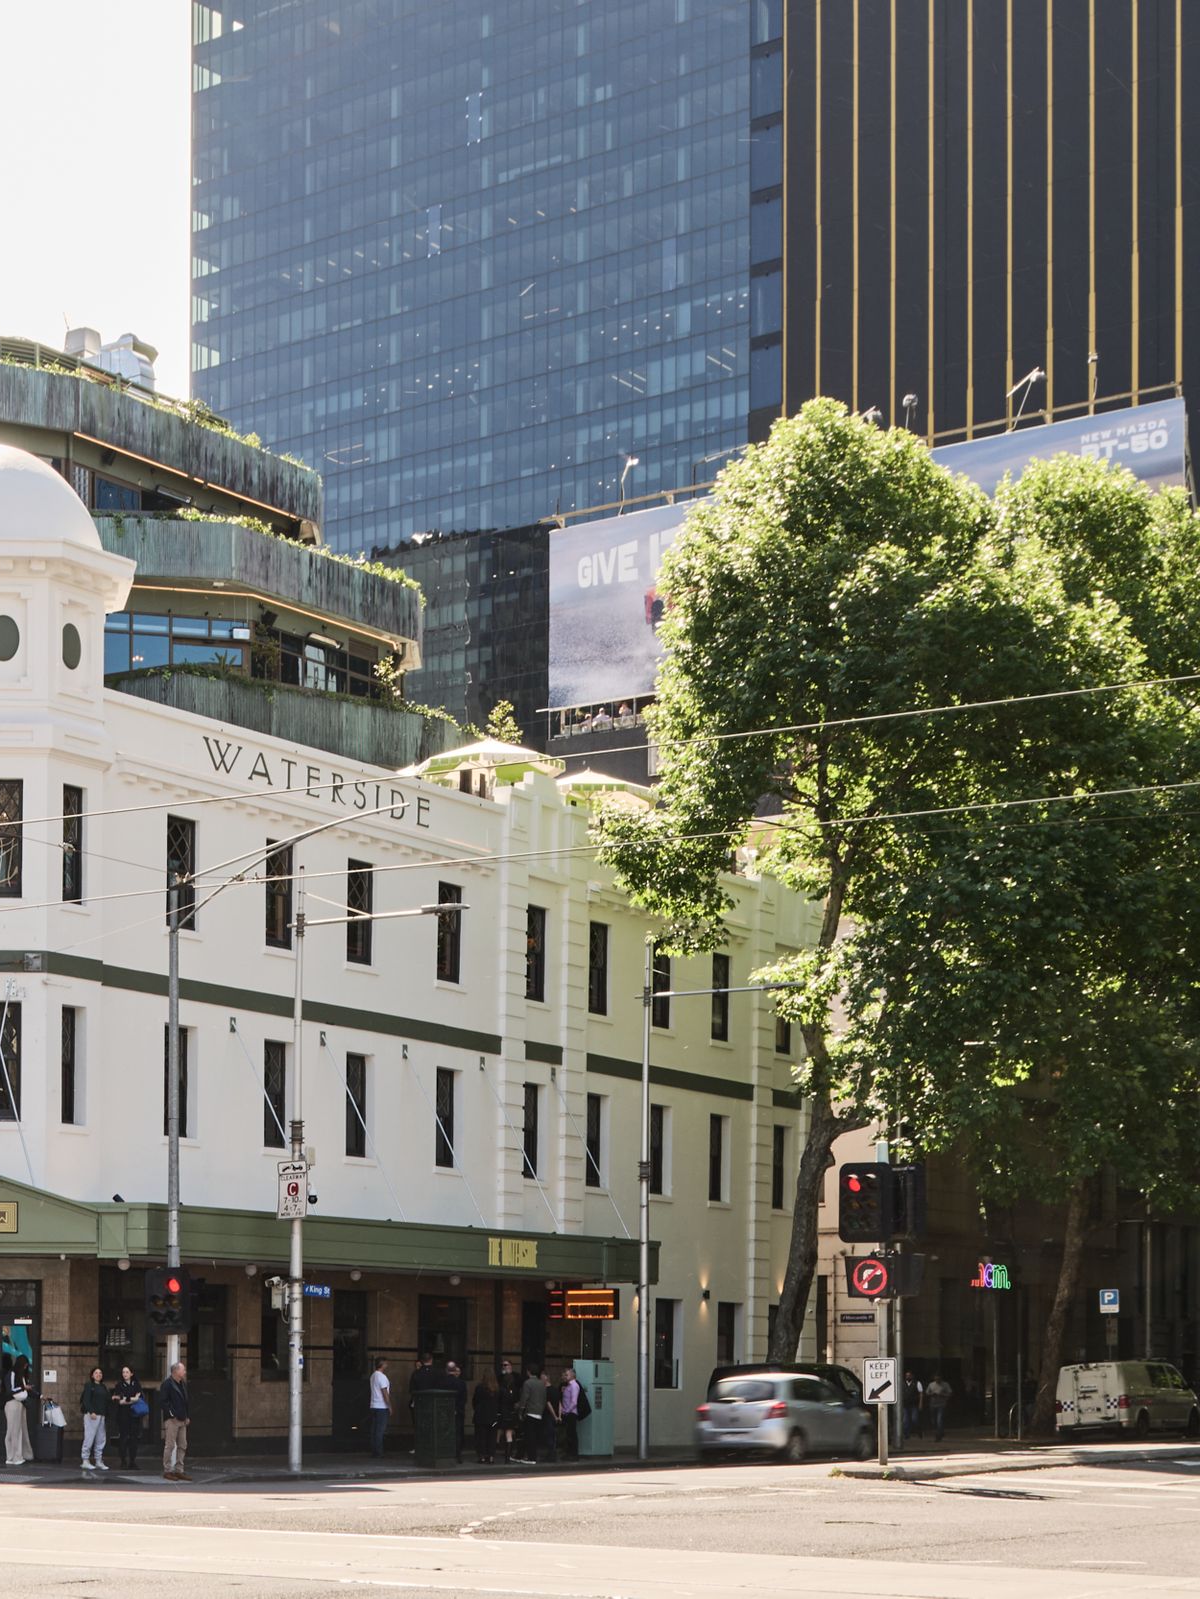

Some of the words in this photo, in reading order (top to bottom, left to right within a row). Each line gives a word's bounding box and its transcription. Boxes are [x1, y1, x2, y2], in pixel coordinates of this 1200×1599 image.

[1081, 429, 1112, 444] NEW
[1116, 418, 1168, 437] MAZDA
[577, 539, 639, 589] GIVE
[202, 735, 431, 829] WATERSIDE
[309, 1284, 323, 1296] King
[323, 1286, 331, 1295] St
[869, 1362, 890, 1371] KEEP
[870, 1371, 888, 1380] LEFT
